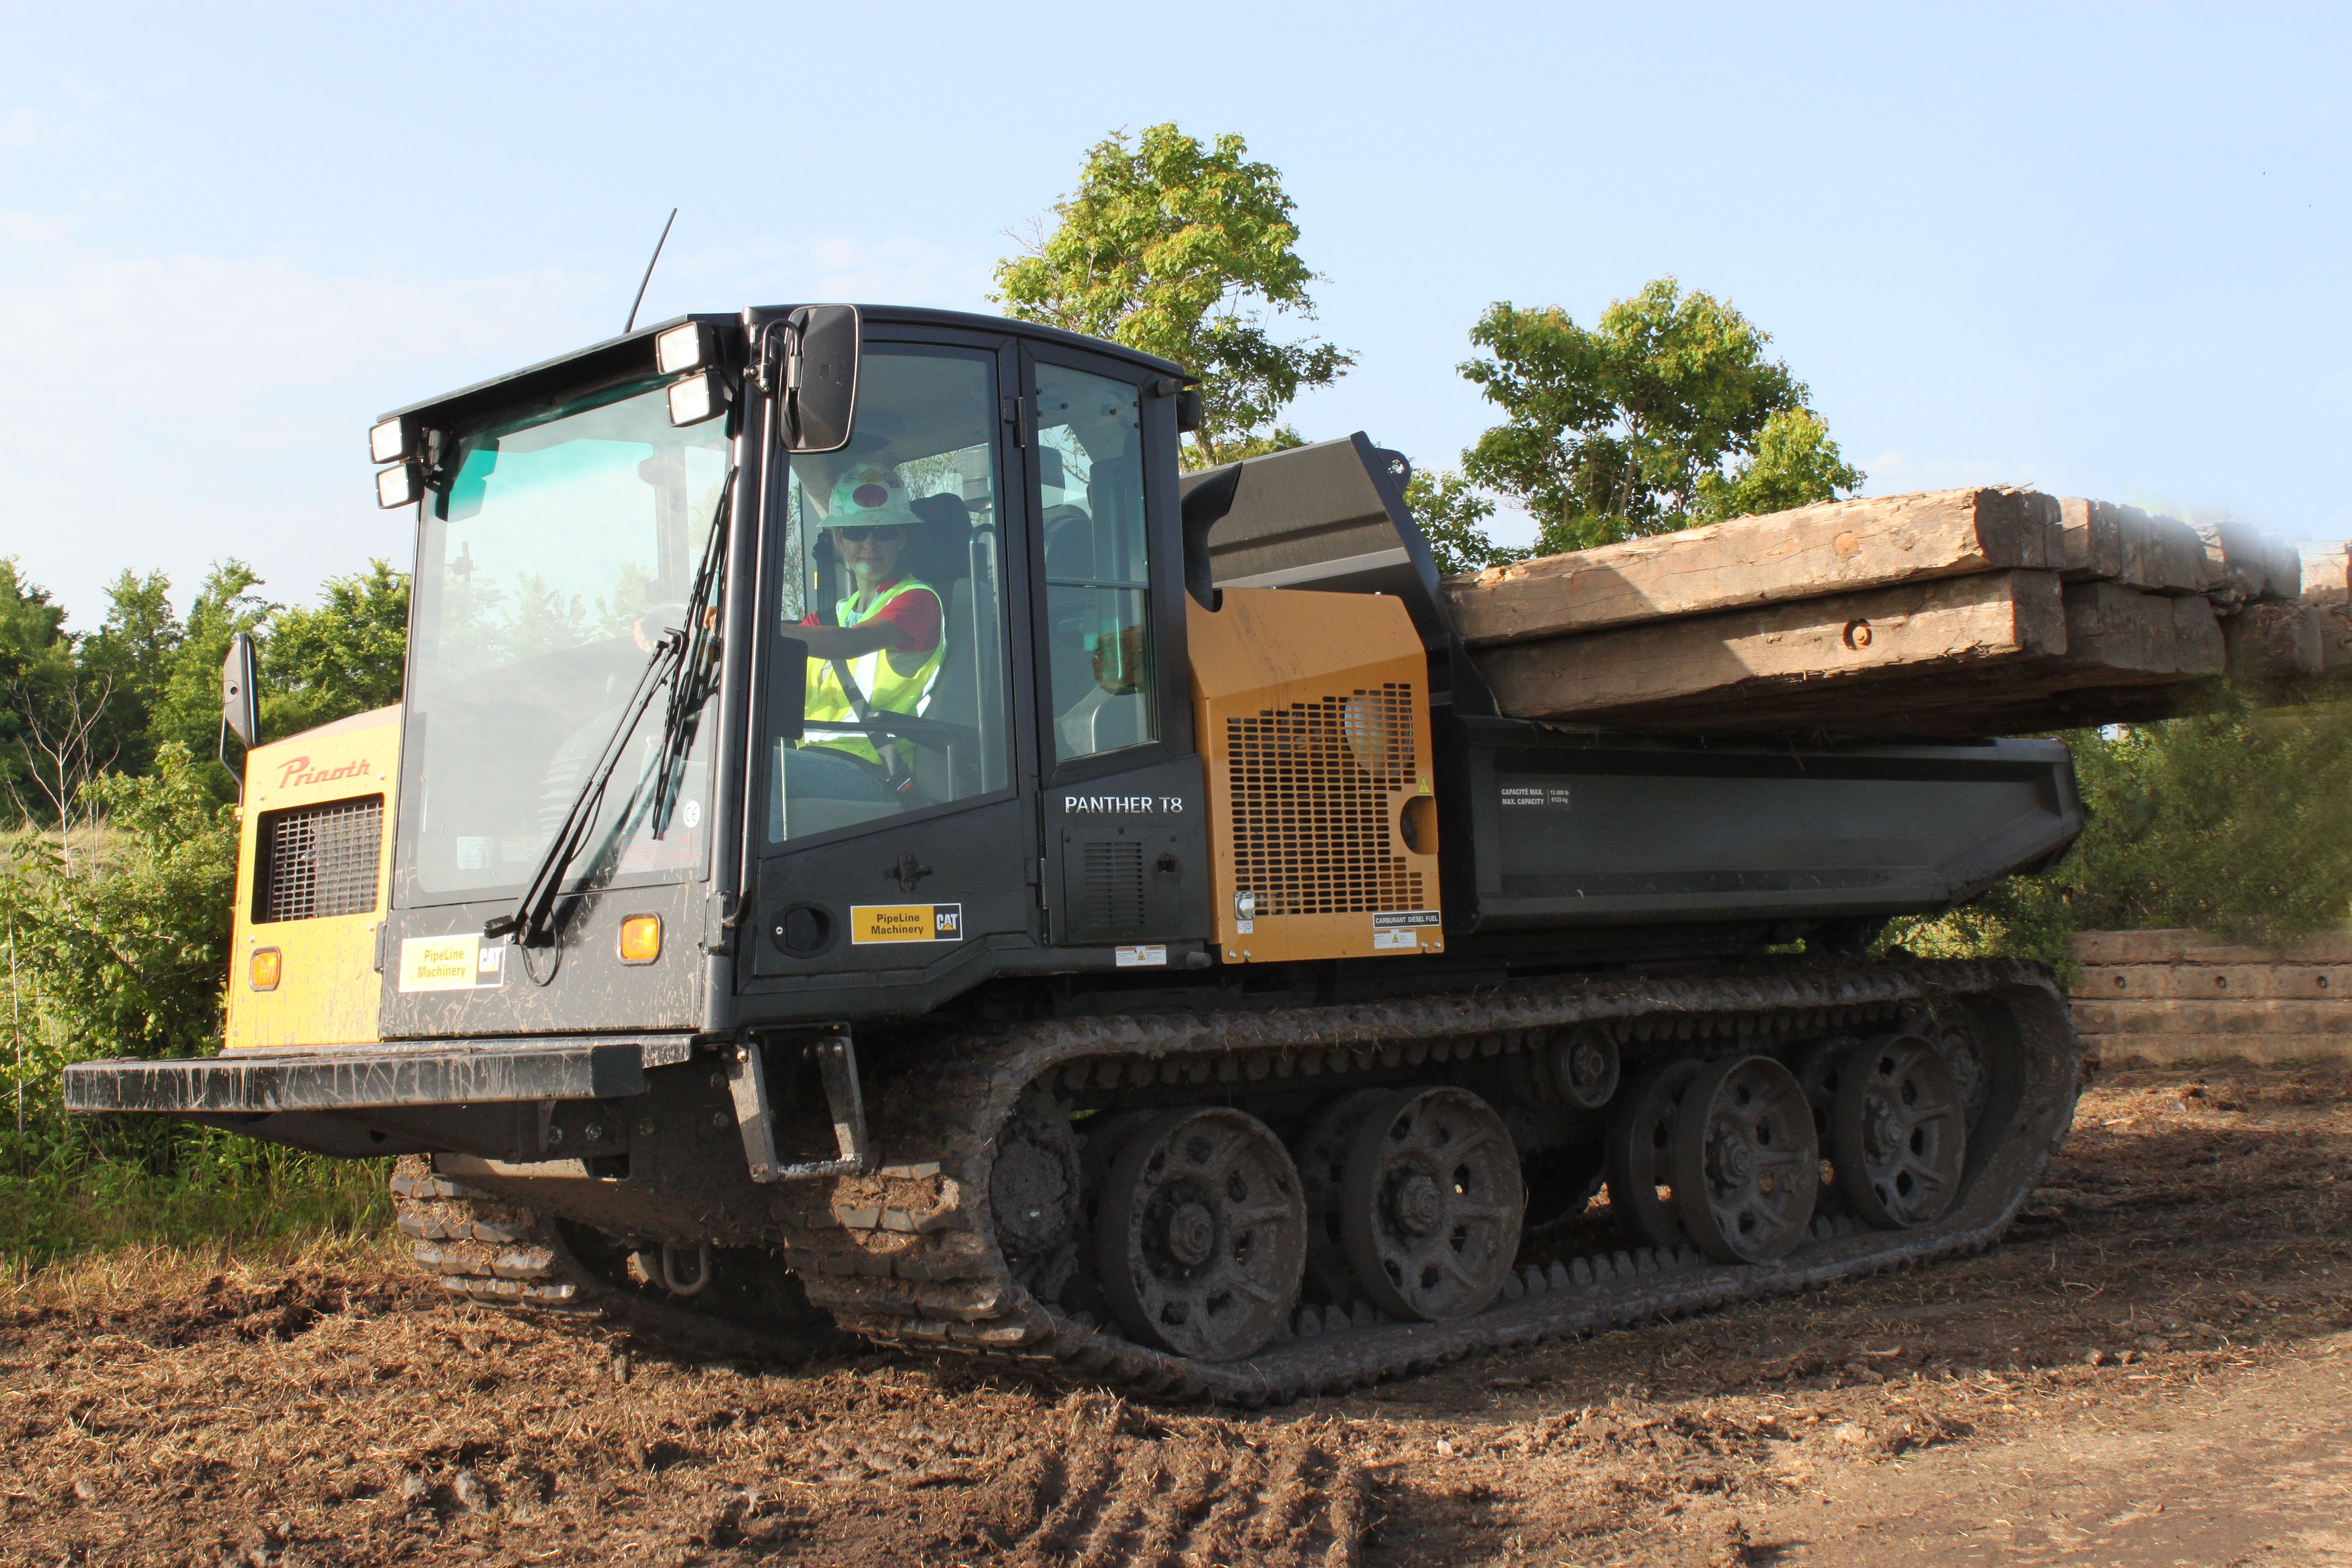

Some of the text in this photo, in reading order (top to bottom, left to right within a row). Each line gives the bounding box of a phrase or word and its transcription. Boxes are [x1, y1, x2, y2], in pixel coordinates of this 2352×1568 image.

[277, 756, 370, 788] Prinoth
[1065, 796, 1183, 813] PANTHER T8
[877, 913, 920, 925] PipeLine
[936, 913, 958, 931] CAT
[871, 925, 924, 935] Machinery
[424, 947, 464, 964] PipeLine
[479, 946, 503, 973] CAT
[417, 965, 466, 978] Machinery
